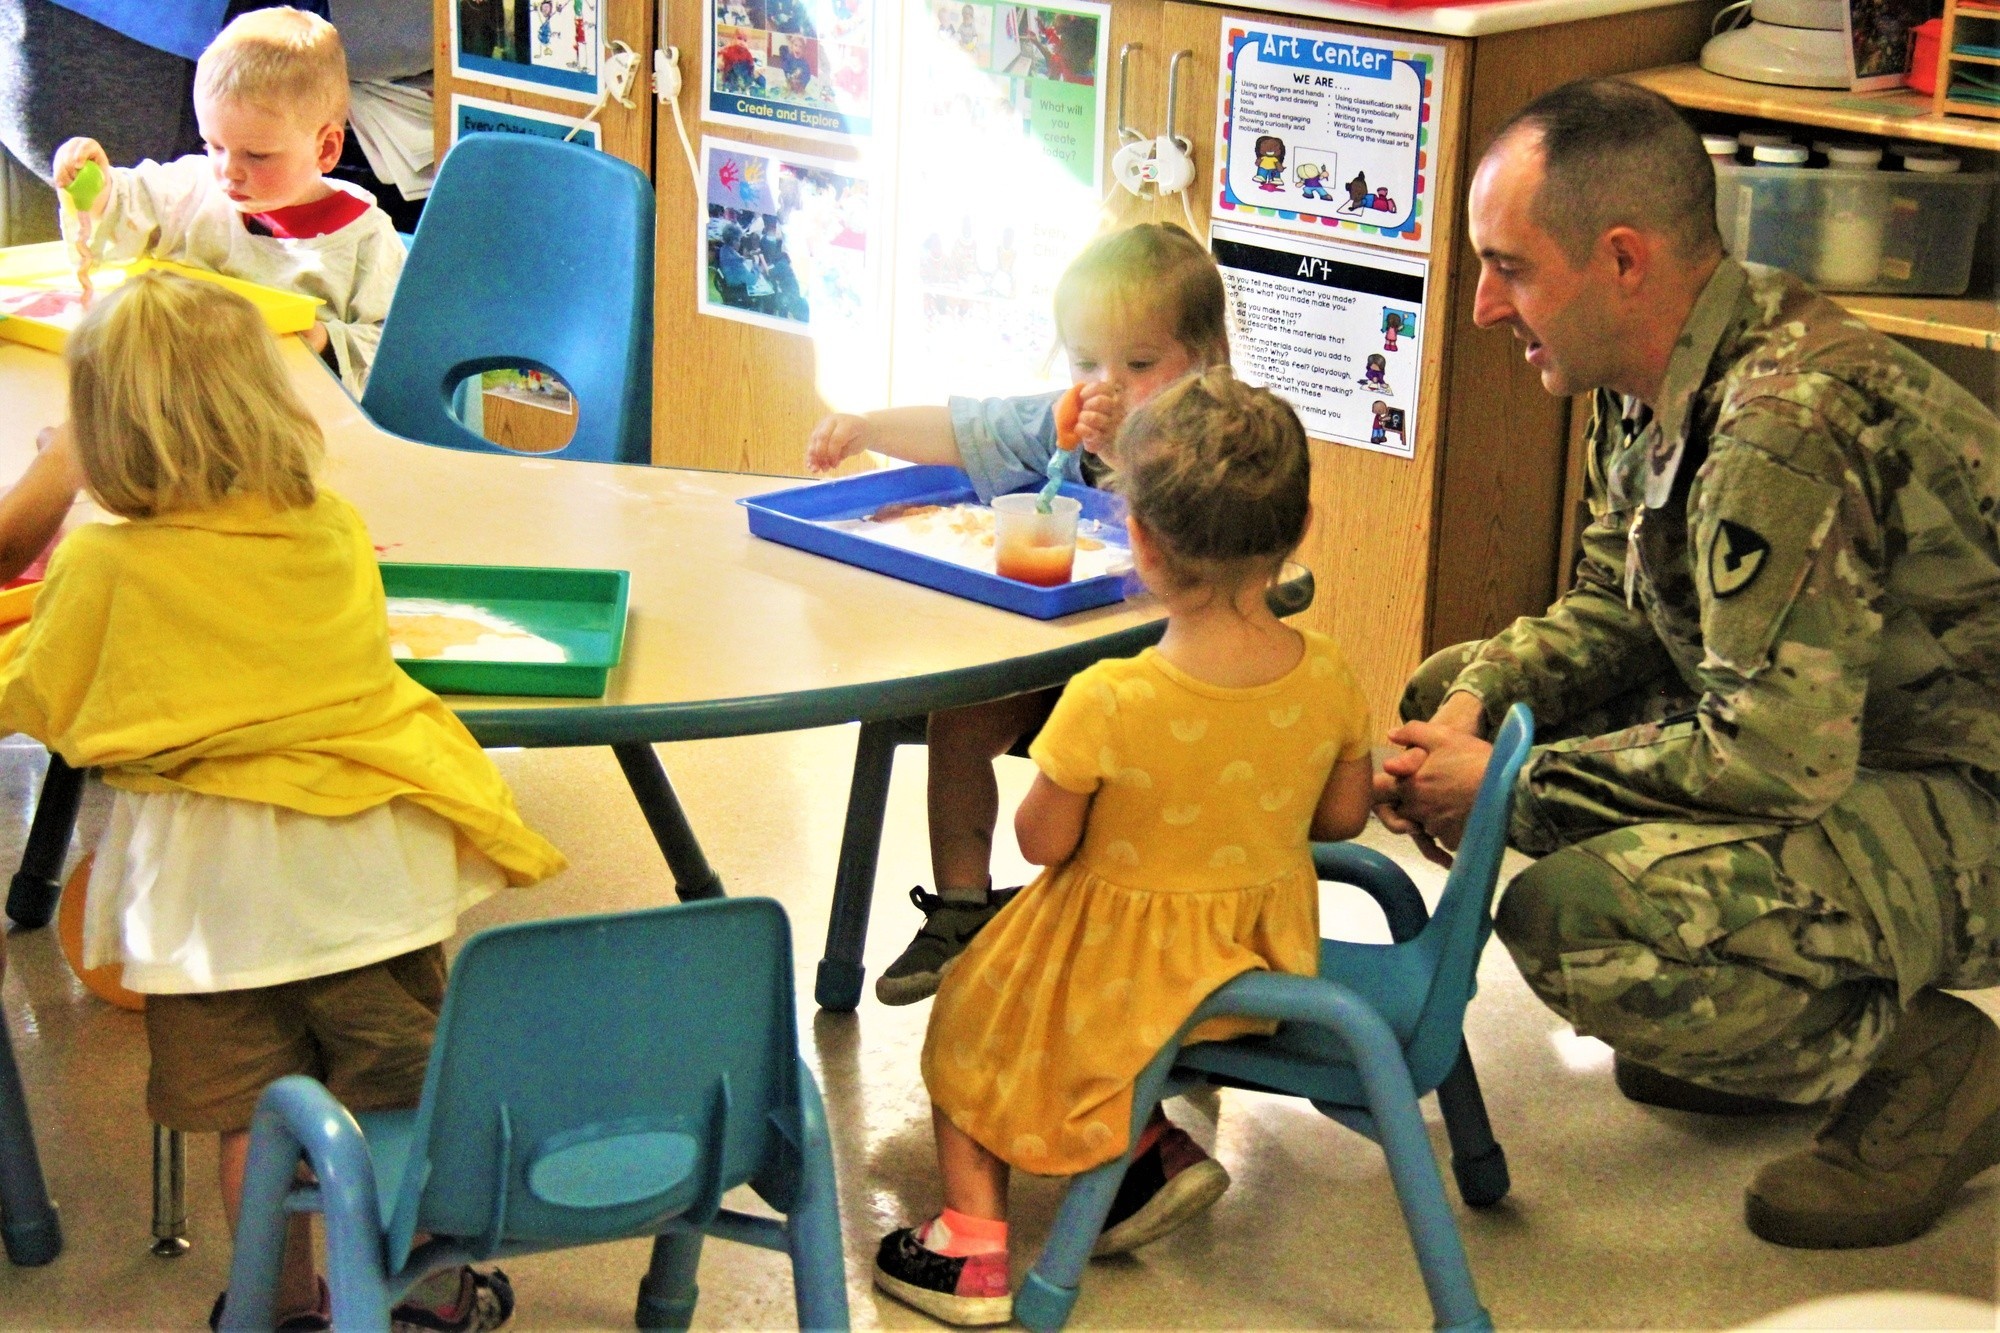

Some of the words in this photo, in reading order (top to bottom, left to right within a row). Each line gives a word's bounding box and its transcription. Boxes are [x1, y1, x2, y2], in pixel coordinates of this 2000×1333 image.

[1263, 34, 1300, 58] Art
[1312, 41, 1387, 70] Center
[1293, 73, 1310, 85] WE
[1241, 80, 1258, 90] Using
[1270, 84, 1291, 94] fingers
[1306, 89, 1324, 98] hands
[1241, 89, 1257, 98] Using
[1258, 92, 1279, 102] writing
[1293, 96, 1319, 107] drawing
[1335, 94, 1352, 104] Using
[1353, 98, 1394, 109] classification
[1395, 103, 1412, 111] skills
[736, 100, 774, 117] Create
[776, 109, 797, 121] and
[800, 111, 840, 128] Explore
[1040, 100, 1064, 112] What
[1067, 105, 1082, 115] will
[1240, 106, 1268, 118] Attending
[1269, 111, 1280, 119] and
[1282, 114, 1311, 124] engaging
[1335, 103, 1360, 114] Thinking
[1361, 107, 1400, 120] symbolically
[464, 116, 494, 132] Every
[1051, 120, 1069, 129] you
[1239, 115, 1264, 126] Showing
[1265, 119, 1292, 130] curiosity
[1293, 123, 1305, 131] and
[1334, 112, 1356, 122] Writing
[1238, 125, 1269, 134] motivation
[1334, 121, 1355, 132] Writing
[1364, 128, 1385, 136] convey
[1386, 130, 1414, 140] meaning
[1336, 130, 1365, 142] Exploring
[1044, 133, 1076, 145] create
[1297, 256, 1332, 280] Art
[1238, 285, 1254, 293] does
[1256, 289, 1274, 297] what
[1290, 295, 1310, 304] made
[1312, 299, 1330, 308] make
[1263, 281, 1273, 289] me
[1275, 284, 1295, 293] about
[1297, 288, 1315, 297] what
[1318, 292, 1331, 300] you
[1332, 295, 1356, 304] made?
[1262, 315, 1285, 324] create
[1263, 307, 1280, 315] make
[1282, 310, 1302, 319] that?
[1248, 319, 1277, 331] describe
[1280, 326, 1291, 334] the
[1293, 330, 1326, 340] materials
[1329, 336, 1344, 344] that
[1259, 339, 1292, 350] materials
[1294, 346, 1312, 354] could
[1314, 350, 1327, 358] you
[1270, 349, 1288, 358] Why?
[1257, 355, 1290, 366] materials
[1292, 361, 1309, 369] feel?
[1276, 374, 1294, 384] what
[1325, 385, 1353, 397] making?
[1284, 385, 1299, 394] with
[1301, 388, 1321, 398] these
[1302, 405, 1326, 415] remind
